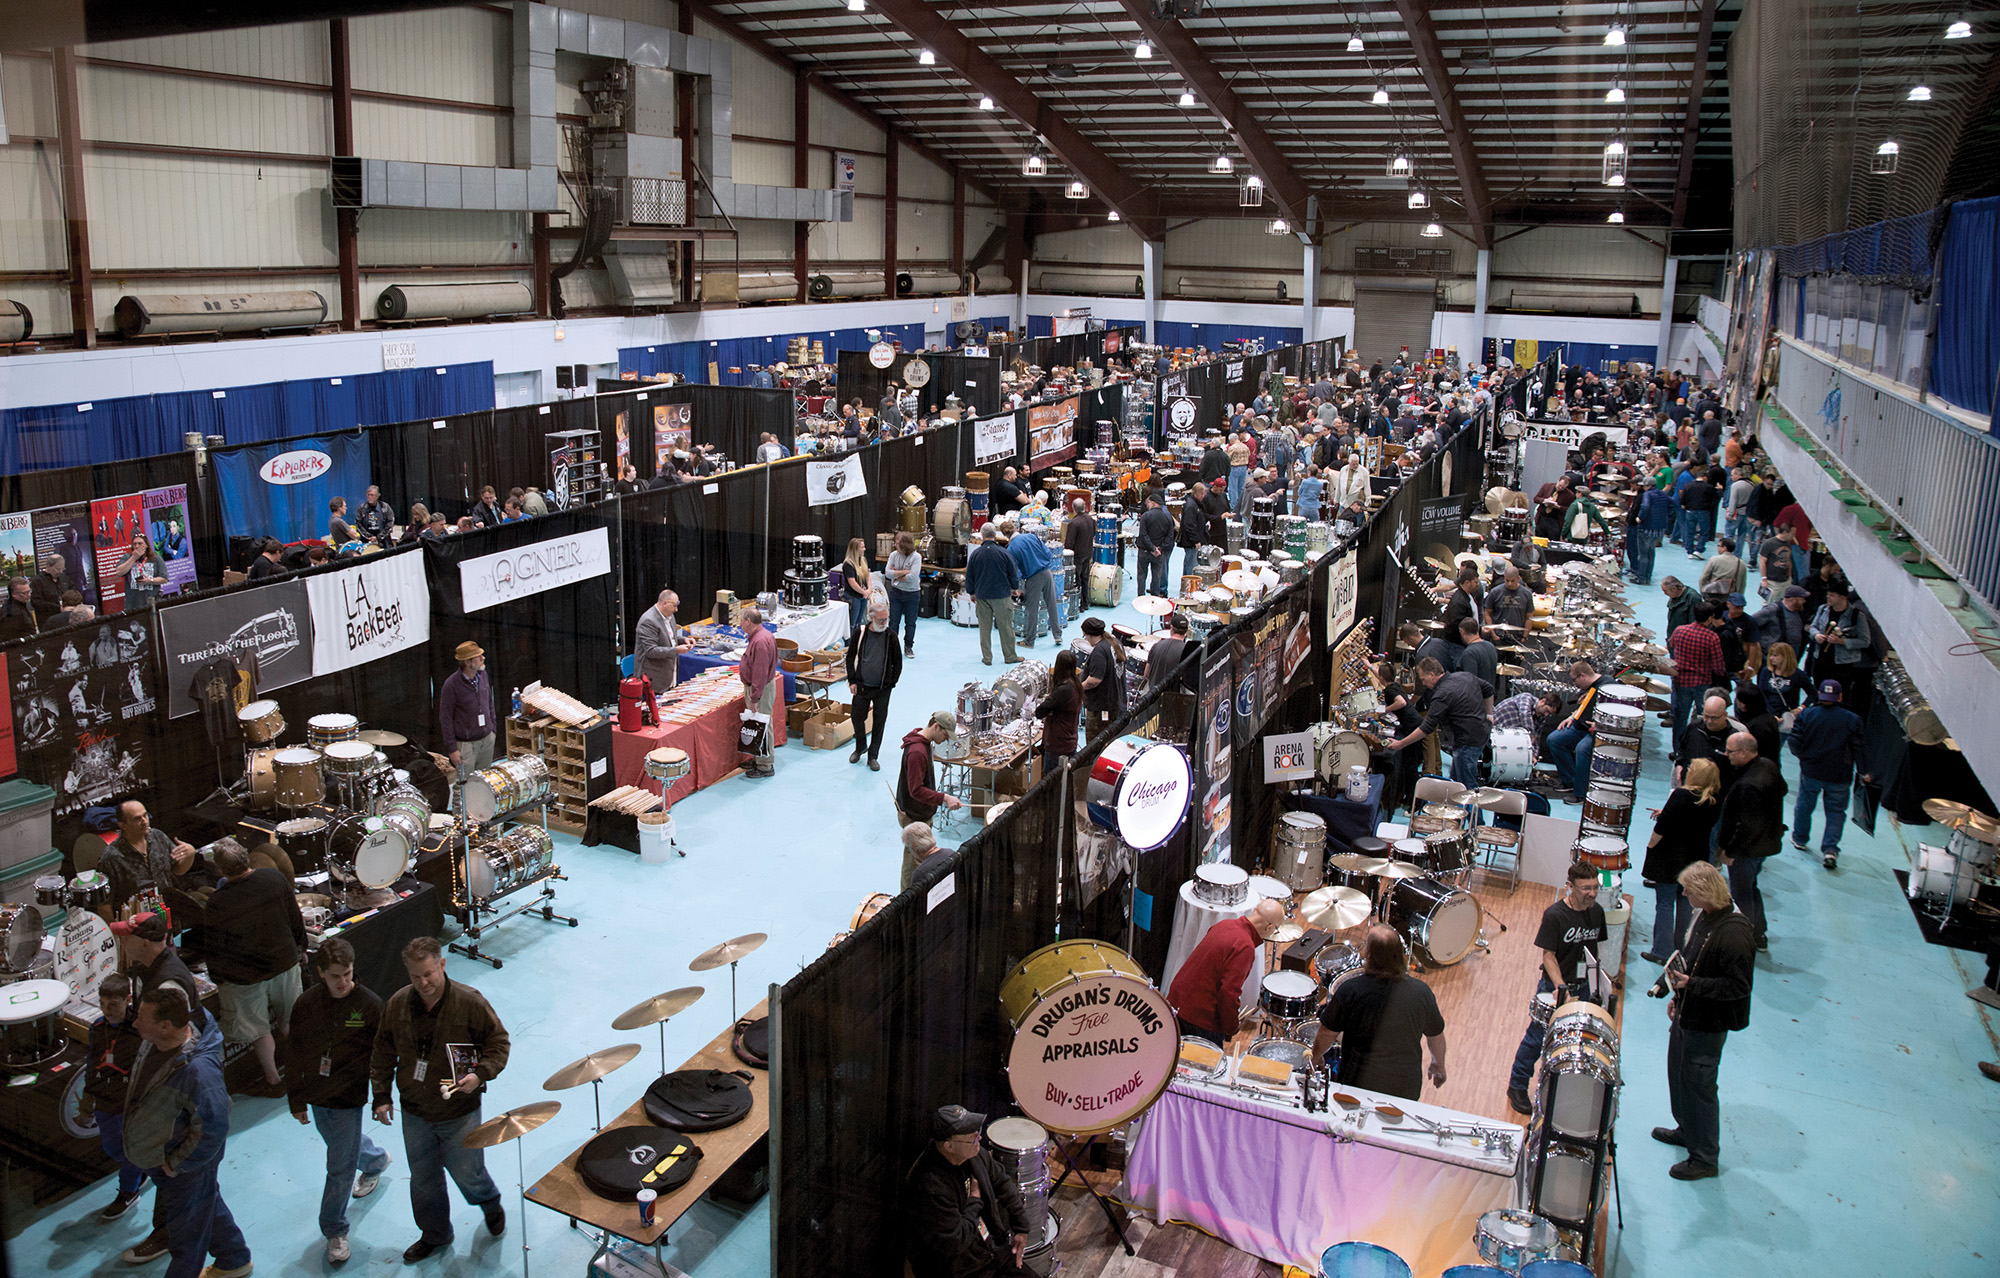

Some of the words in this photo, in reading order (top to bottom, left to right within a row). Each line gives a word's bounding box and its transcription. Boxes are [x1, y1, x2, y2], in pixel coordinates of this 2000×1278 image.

[1541, 428, 1581, 438] LATIN
[271, 456, 325, 479] EXPLORERS
[142, 493, 164, 509] HUMES
[169, 487, 187, 504] BERG
[7, 515, 28, 529] BERG
[1421, 508, 1437, 520] LOW
[1437, 504, 1462, 518] VOLUME
[492, 541, 583, 593] AGNER
[342, 573, 371, 620] LA
[347, 598, 403, 651] BackBeat
[76, 729, 121, 752] Rush
[1274, 742, 1303, 756] ARENA
[1274, 753, 1305, 770] ROCK
[1127, 780, 1178, 807] Chicago
[1141, 796, 1160, 810] DRUM
[367, 835, 388, 850] Pearl
[1031, 982, 1112, 1039] DRUGAN'S
[1113, 988, 1164, 1036] DRUMS
[1068, 1012, 1110, 1036] Free
[1042, 1037, 1140, 1064] APPRAISALS
[1045, 1081, 1069, 1107] BUY
[1073, 1094, 1105, 1112] SELL
[1106, 1070, 1144, 1105] TRADE
